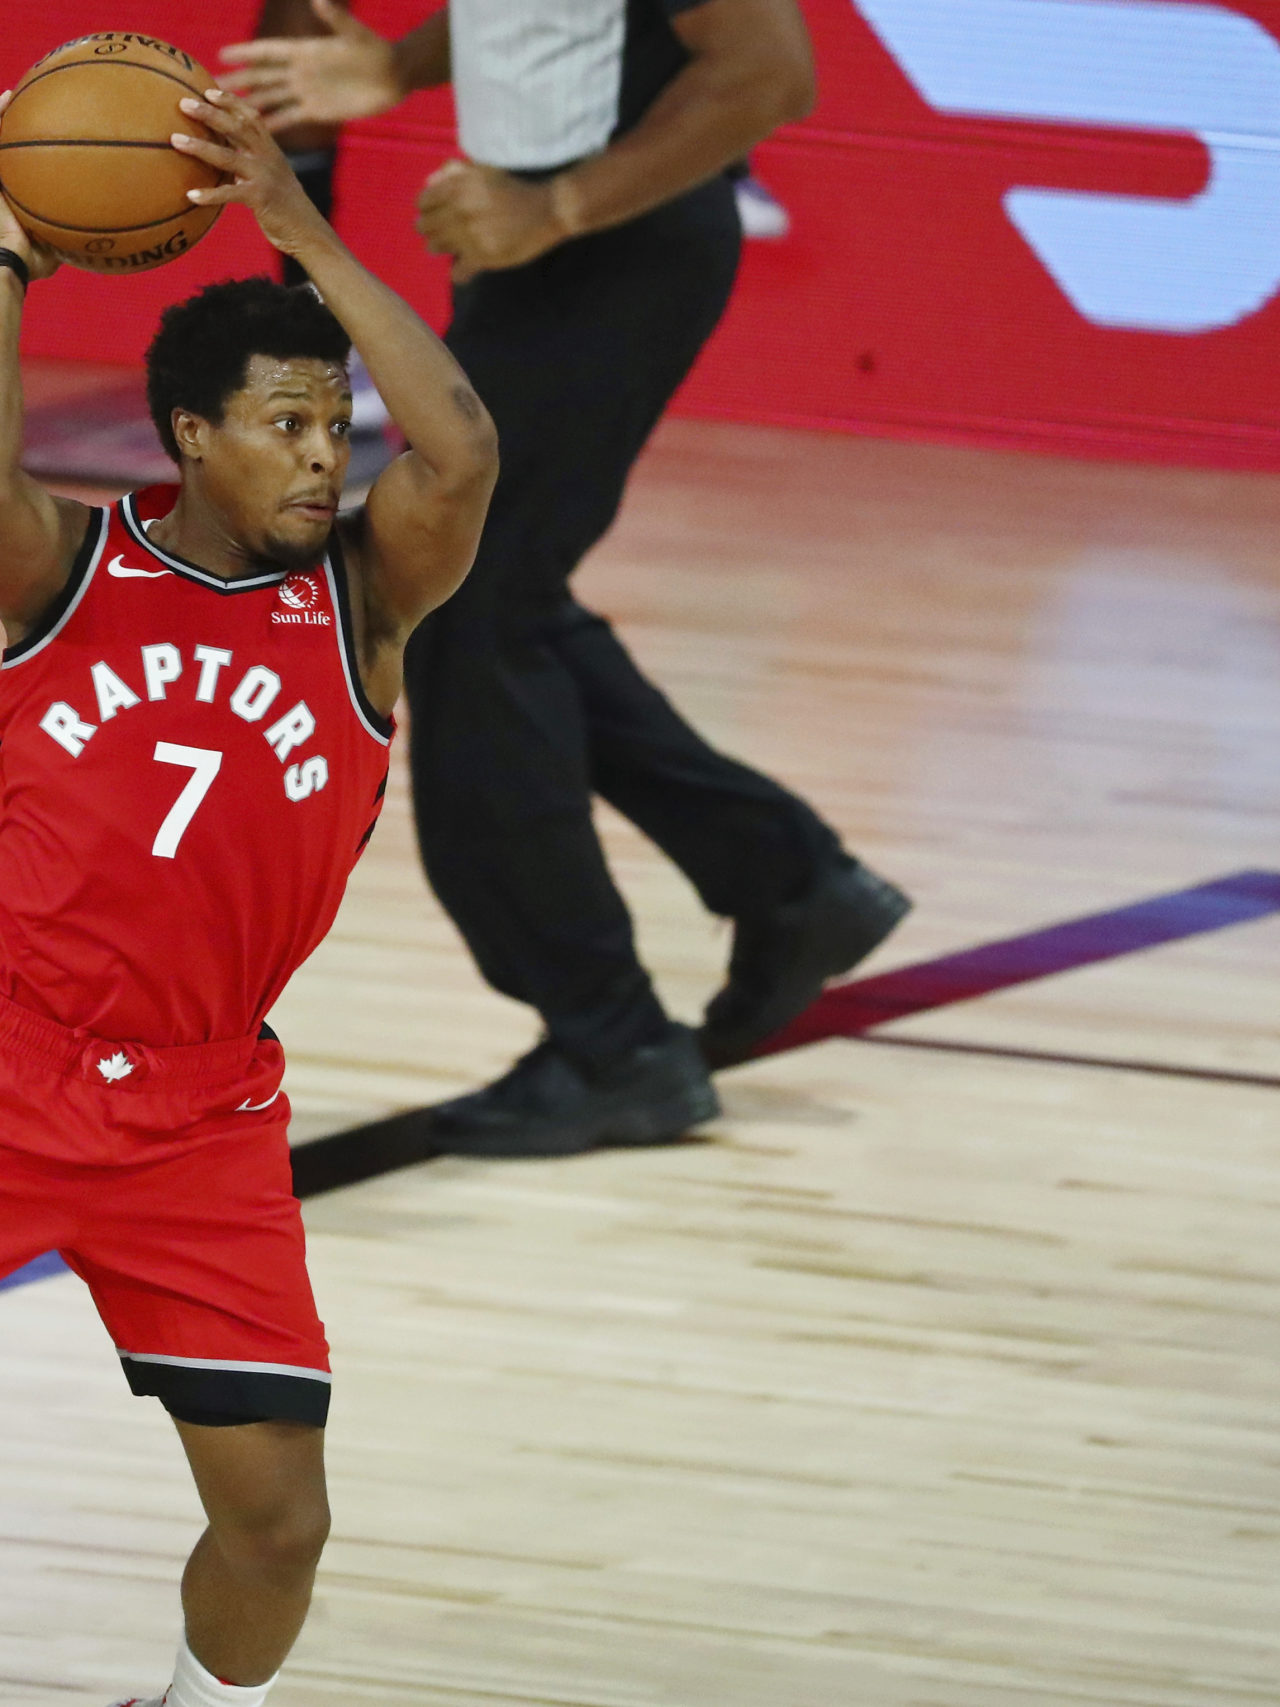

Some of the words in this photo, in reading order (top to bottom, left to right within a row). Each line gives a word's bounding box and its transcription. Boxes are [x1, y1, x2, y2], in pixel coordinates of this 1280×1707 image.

[271, 611, 302, 624] Sun
[304, 611, 331, 626] Life
[39, 643, 329, 803] RAPTORS
[152, 741, 223, 859] 7
